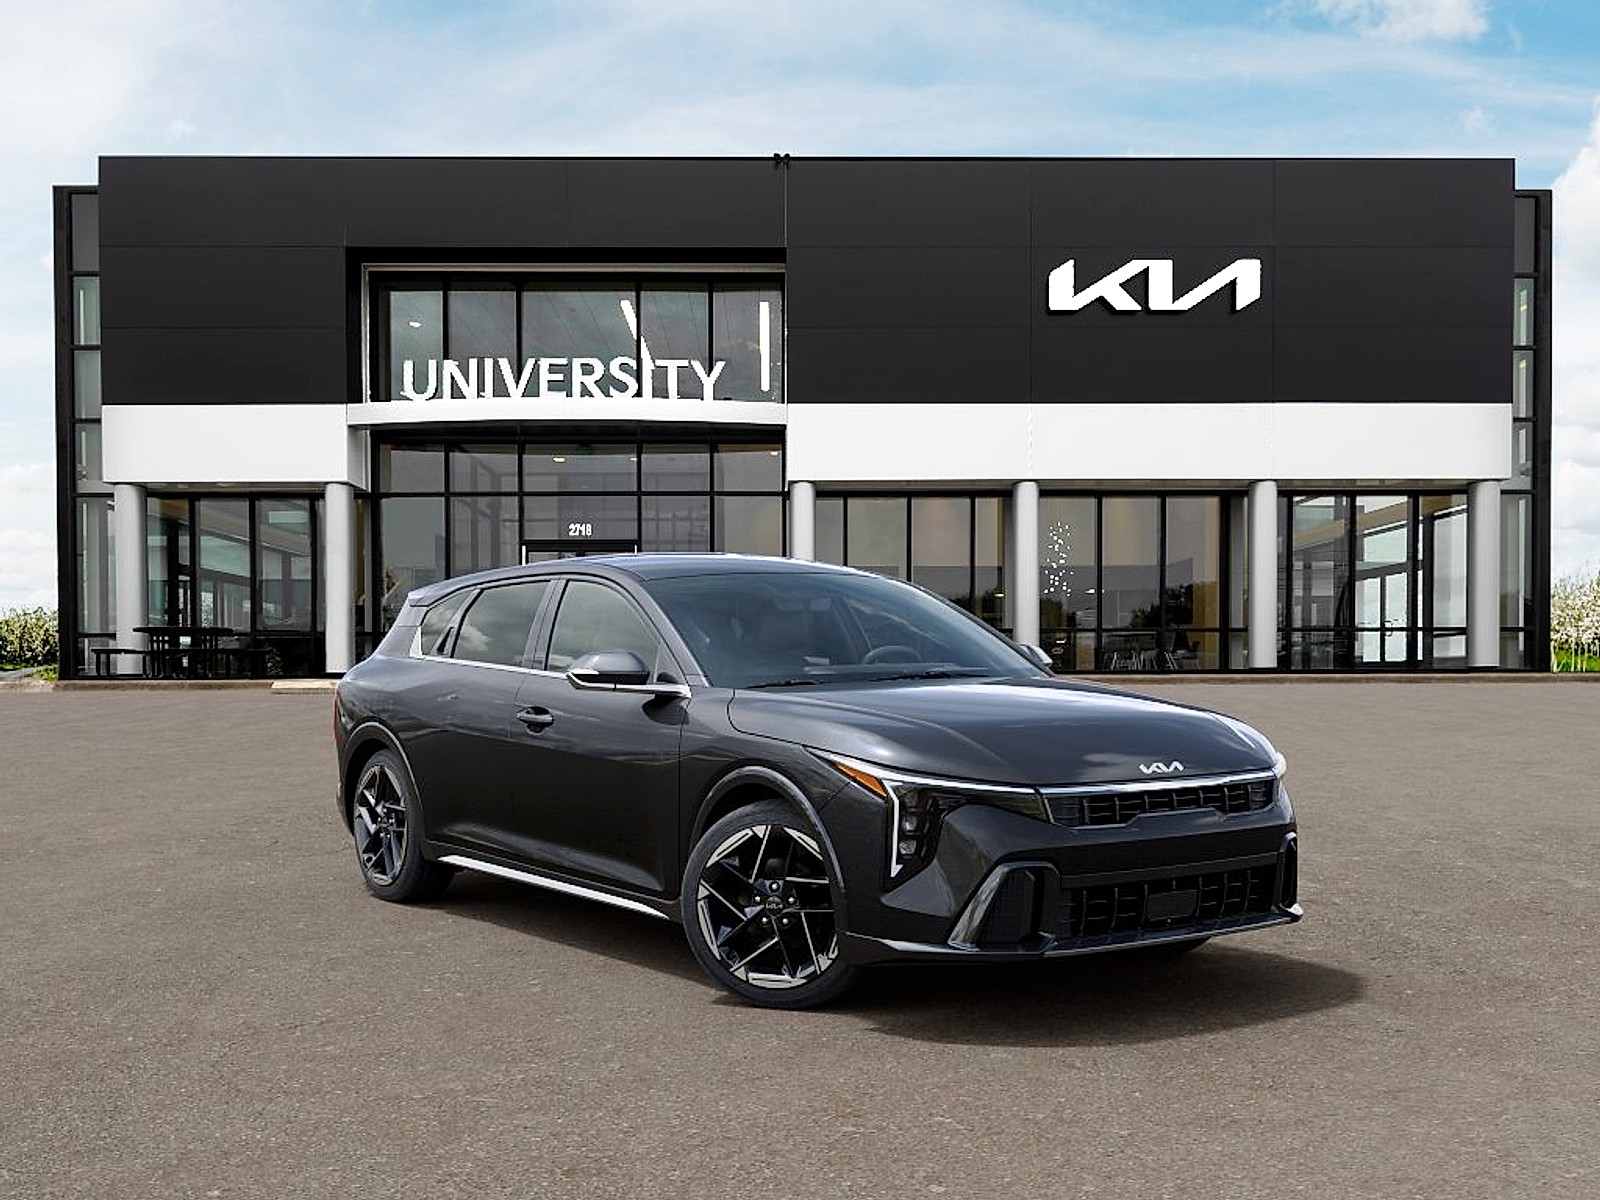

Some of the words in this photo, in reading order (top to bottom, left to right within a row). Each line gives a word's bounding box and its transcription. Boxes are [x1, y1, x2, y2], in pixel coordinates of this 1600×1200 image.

[1048, 259, 1261, 310] KIA
[401, 357, 726, 401] UNIVERSITY
[568, 523, 592, 536] 2718
